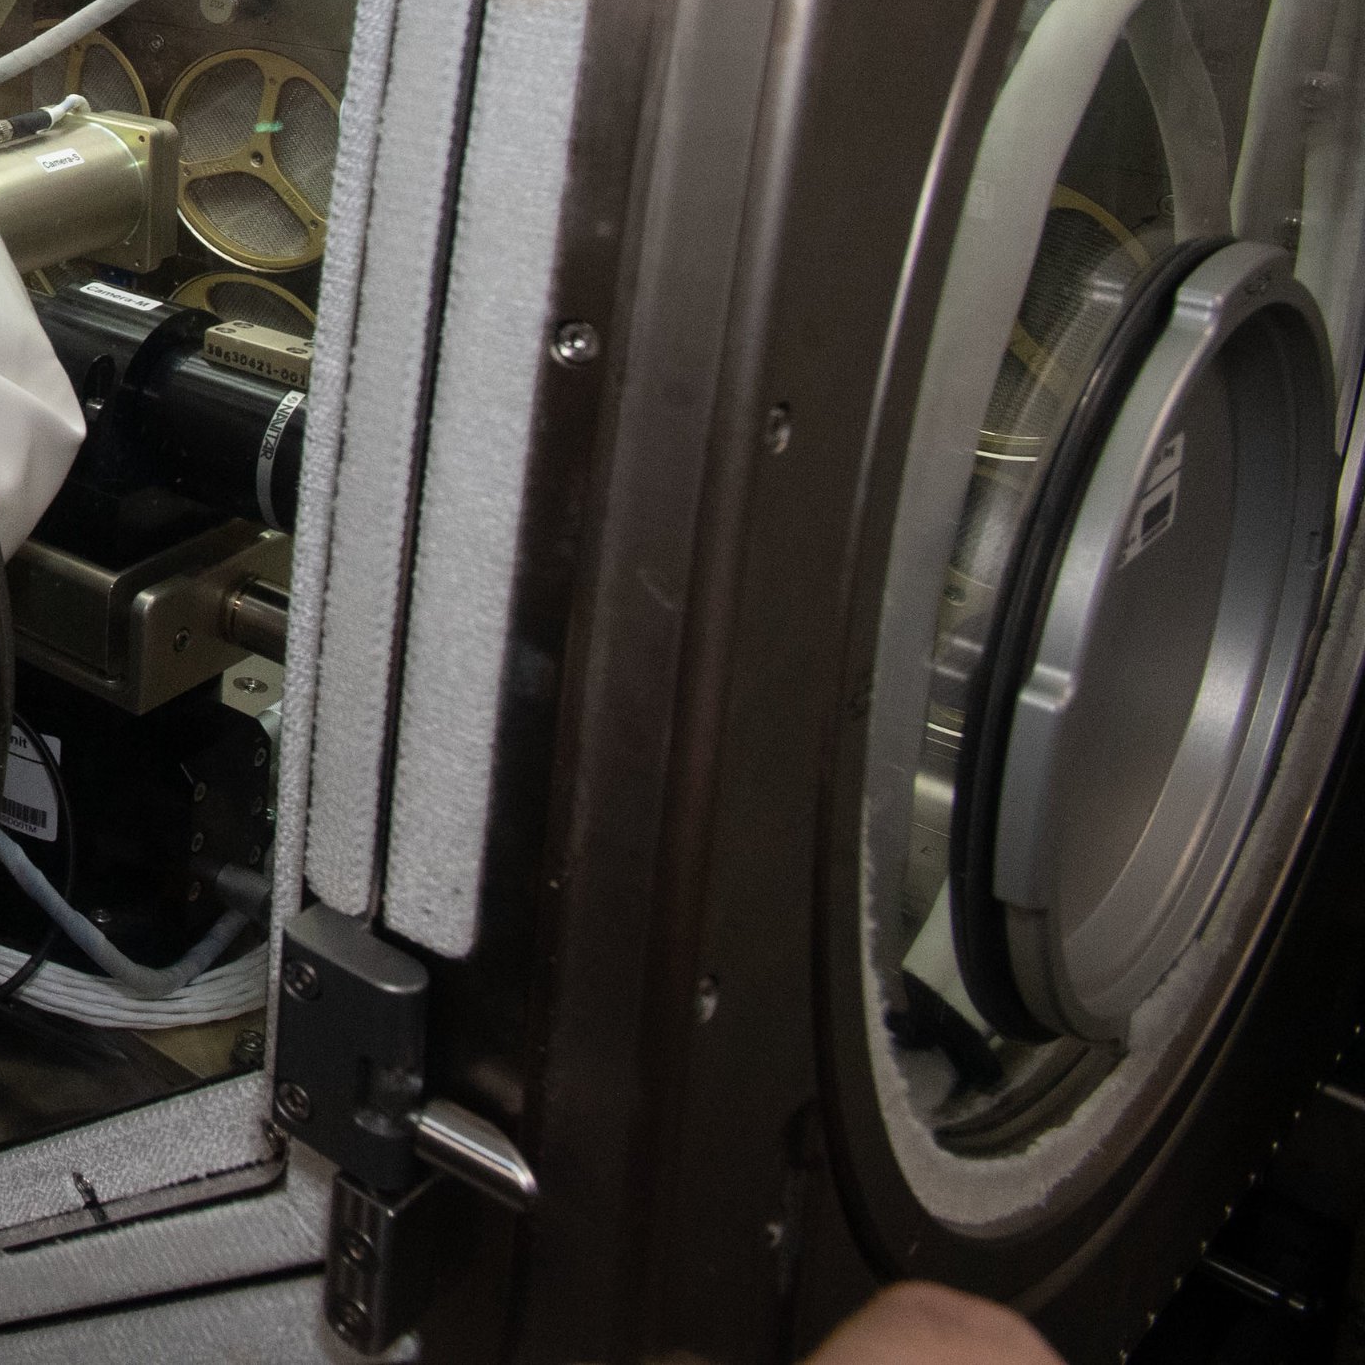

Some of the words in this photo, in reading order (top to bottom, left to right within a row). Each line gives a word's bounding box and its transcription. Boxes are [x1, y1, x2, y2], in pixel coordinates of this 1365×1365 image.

[42, 153, 81, 170] Camera-S
[86, 284, 150, 308] Camera-M
[260, 403, 295, 461] NAVITAR
